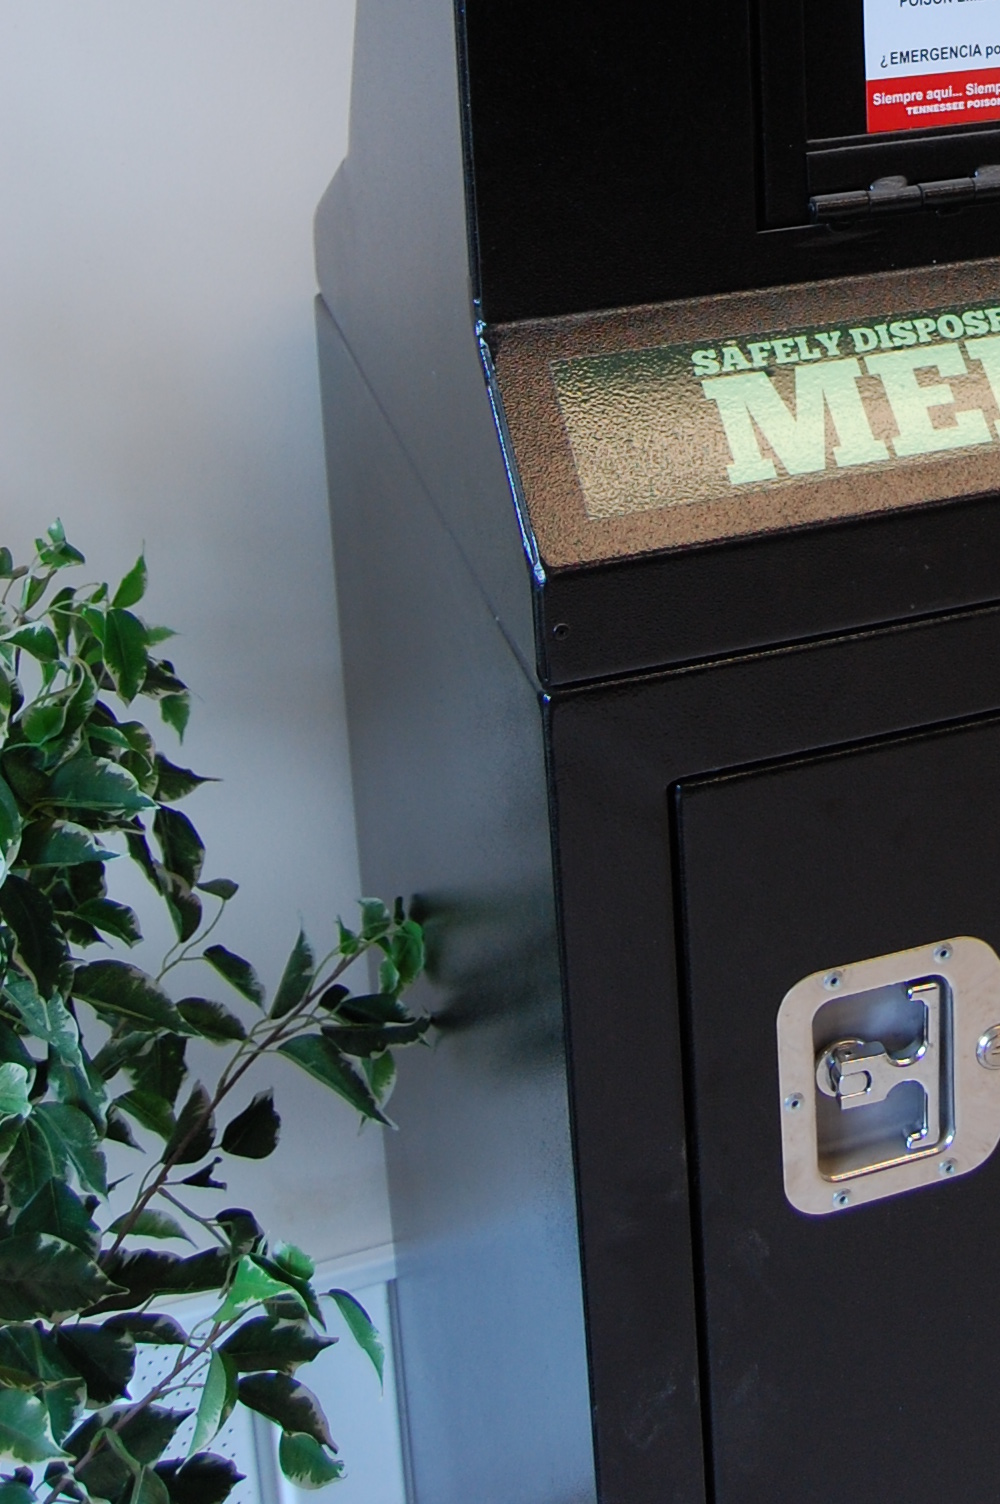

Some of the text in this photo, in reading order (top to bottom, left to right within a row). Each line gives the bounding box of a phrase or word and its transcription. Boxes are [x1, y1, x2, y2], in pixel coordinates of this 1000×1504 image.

[880, 44, 982, 68] ¿EMERGENCIA
[873, 90, 924, 106] Siempre
[906, 101, 965, 116] TENNESSEE
[691, 331, 843, 376] SAFELY
